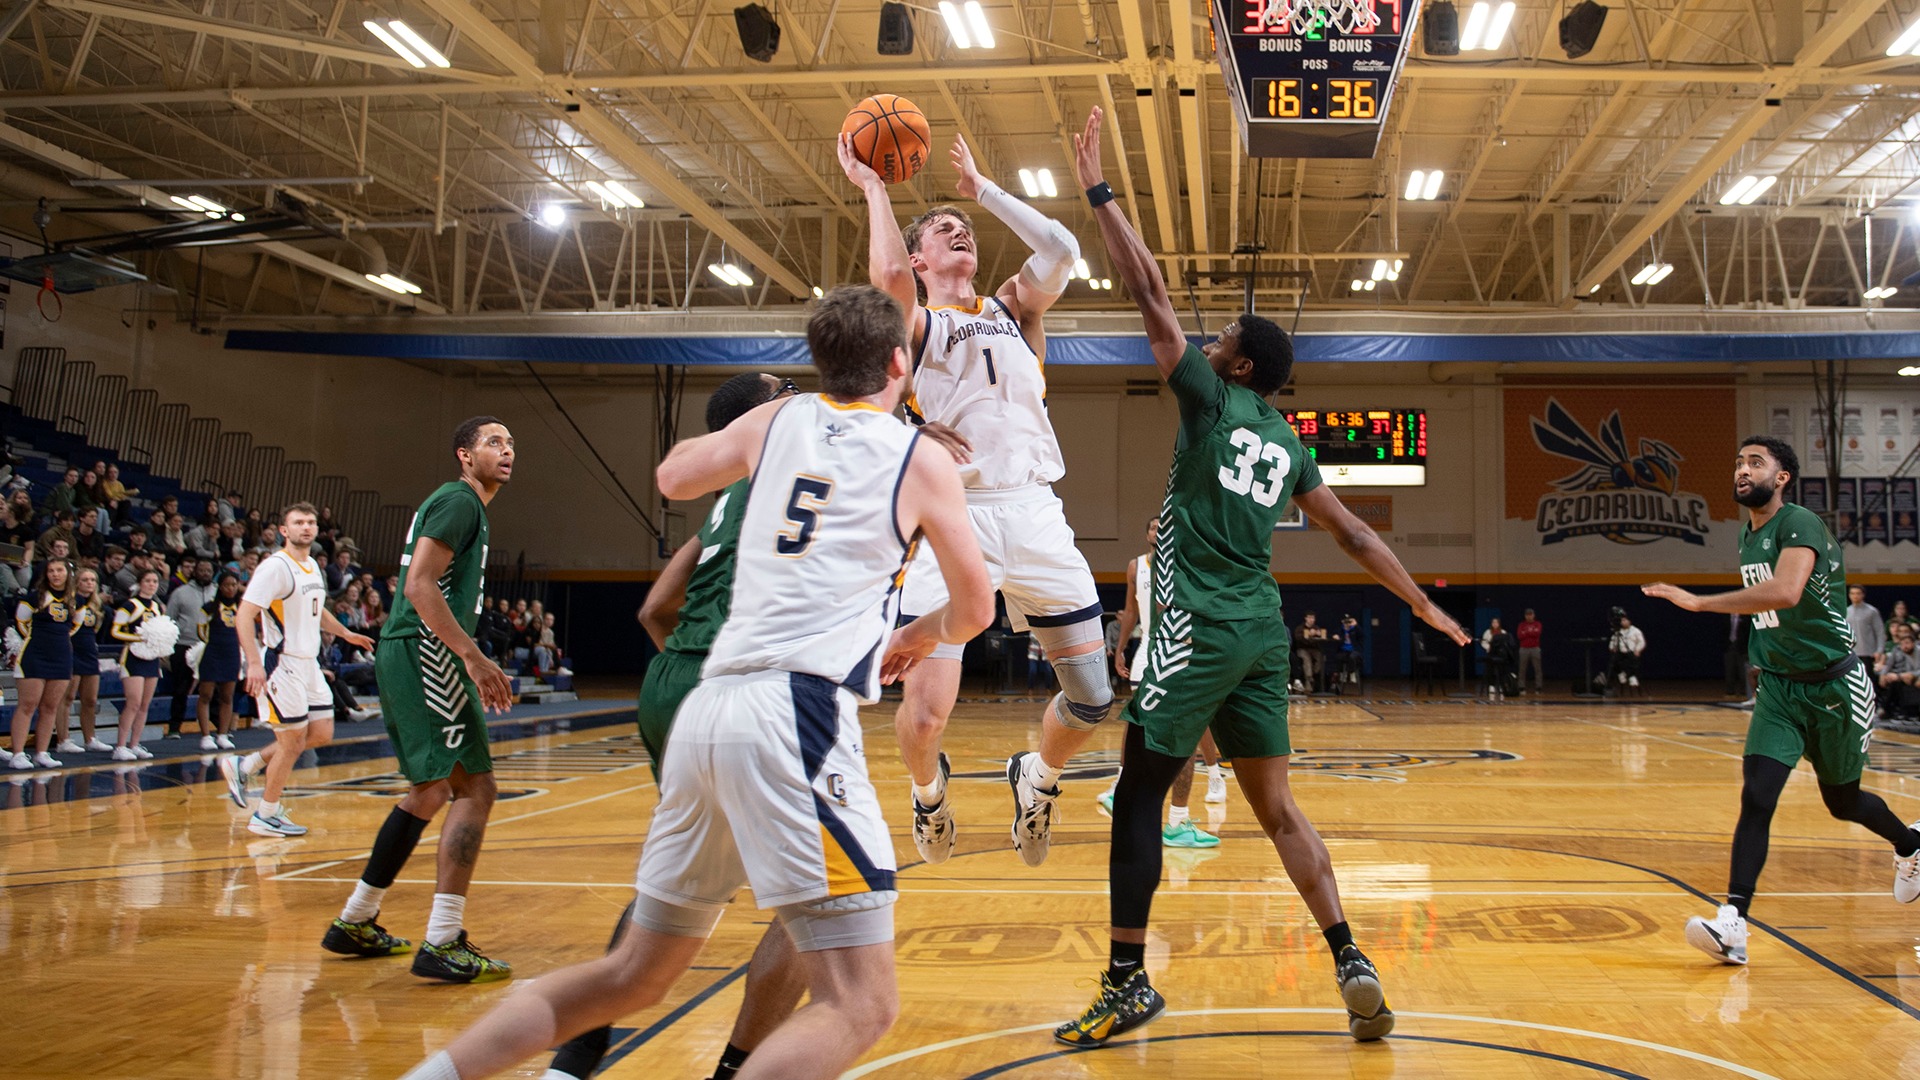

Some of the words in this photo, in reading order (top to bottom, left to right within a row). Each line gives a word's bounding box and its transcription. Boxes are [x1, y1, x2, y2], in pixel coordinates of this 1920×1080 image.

[1259, 38, 1302, 52] BONUS
[1329, 39, 1372, 53] BONUS
[1302, 59, 1328, 70] POSS
[1268, 80, 1375, 117] 16:36
[947, 321, 1018, 353] CEDARVILLE
[981, 348, 997, 386] 1
[1300, 420, 1318, 434] 33
[1326, 412, 1364, 427] 16:36
[1372, 420, 1391, 434] 37
[1347, 429, 1356, 441] 2
[1376, 447, 1385, 459] 3
[1218, 427, 1291, 508] 33
[775, 474, 835, 558] 5
[1537, 493, 1709, 534] CEDARVILLE
[1741, 562, 1774, 588] FFIN
